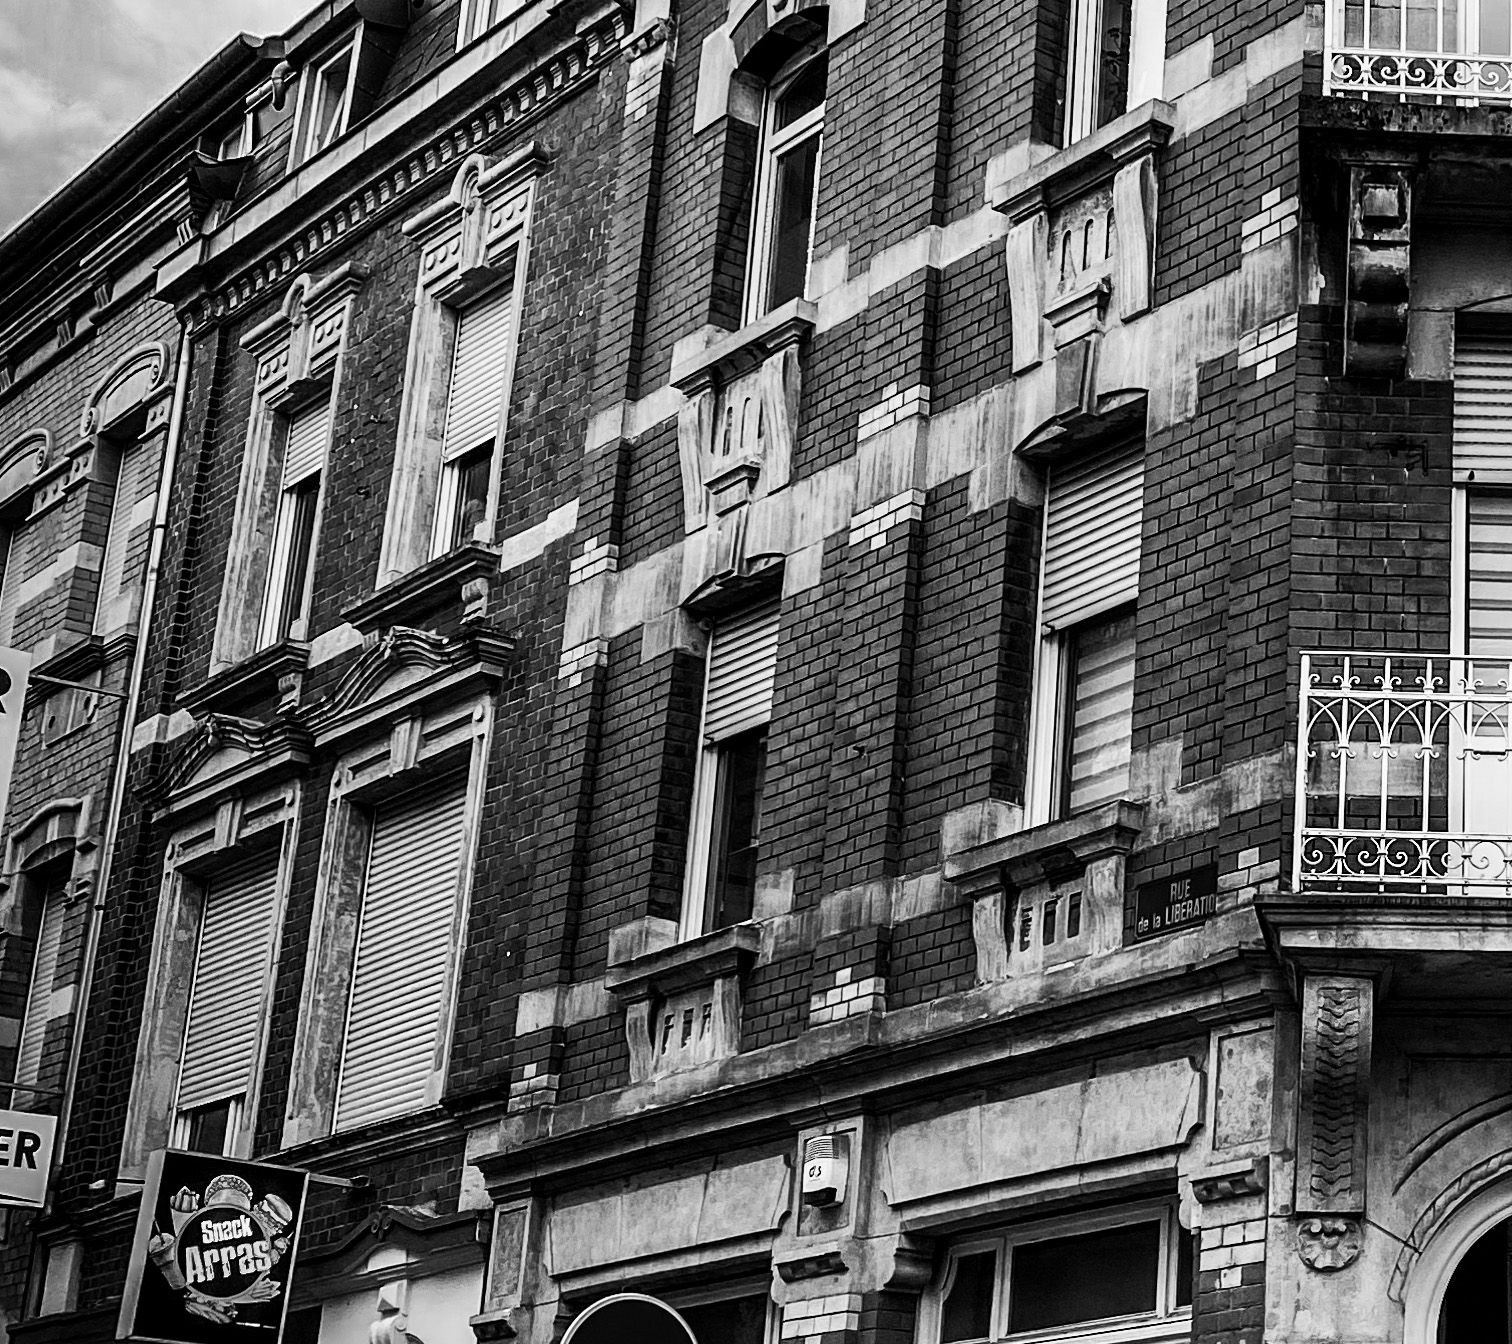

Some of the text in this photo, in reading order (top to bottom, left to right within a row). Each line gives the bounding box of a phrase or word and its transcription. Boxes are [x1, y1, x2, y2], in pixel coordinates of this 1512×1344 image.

[1170, 879, 1191, 903] RUE
[1138, 917, 1149, 933] de
[1153, 913, 1161, 929] la
[201, 1214, 253, 1244] Snack
[185, 1240, 272, 1284] Arras
